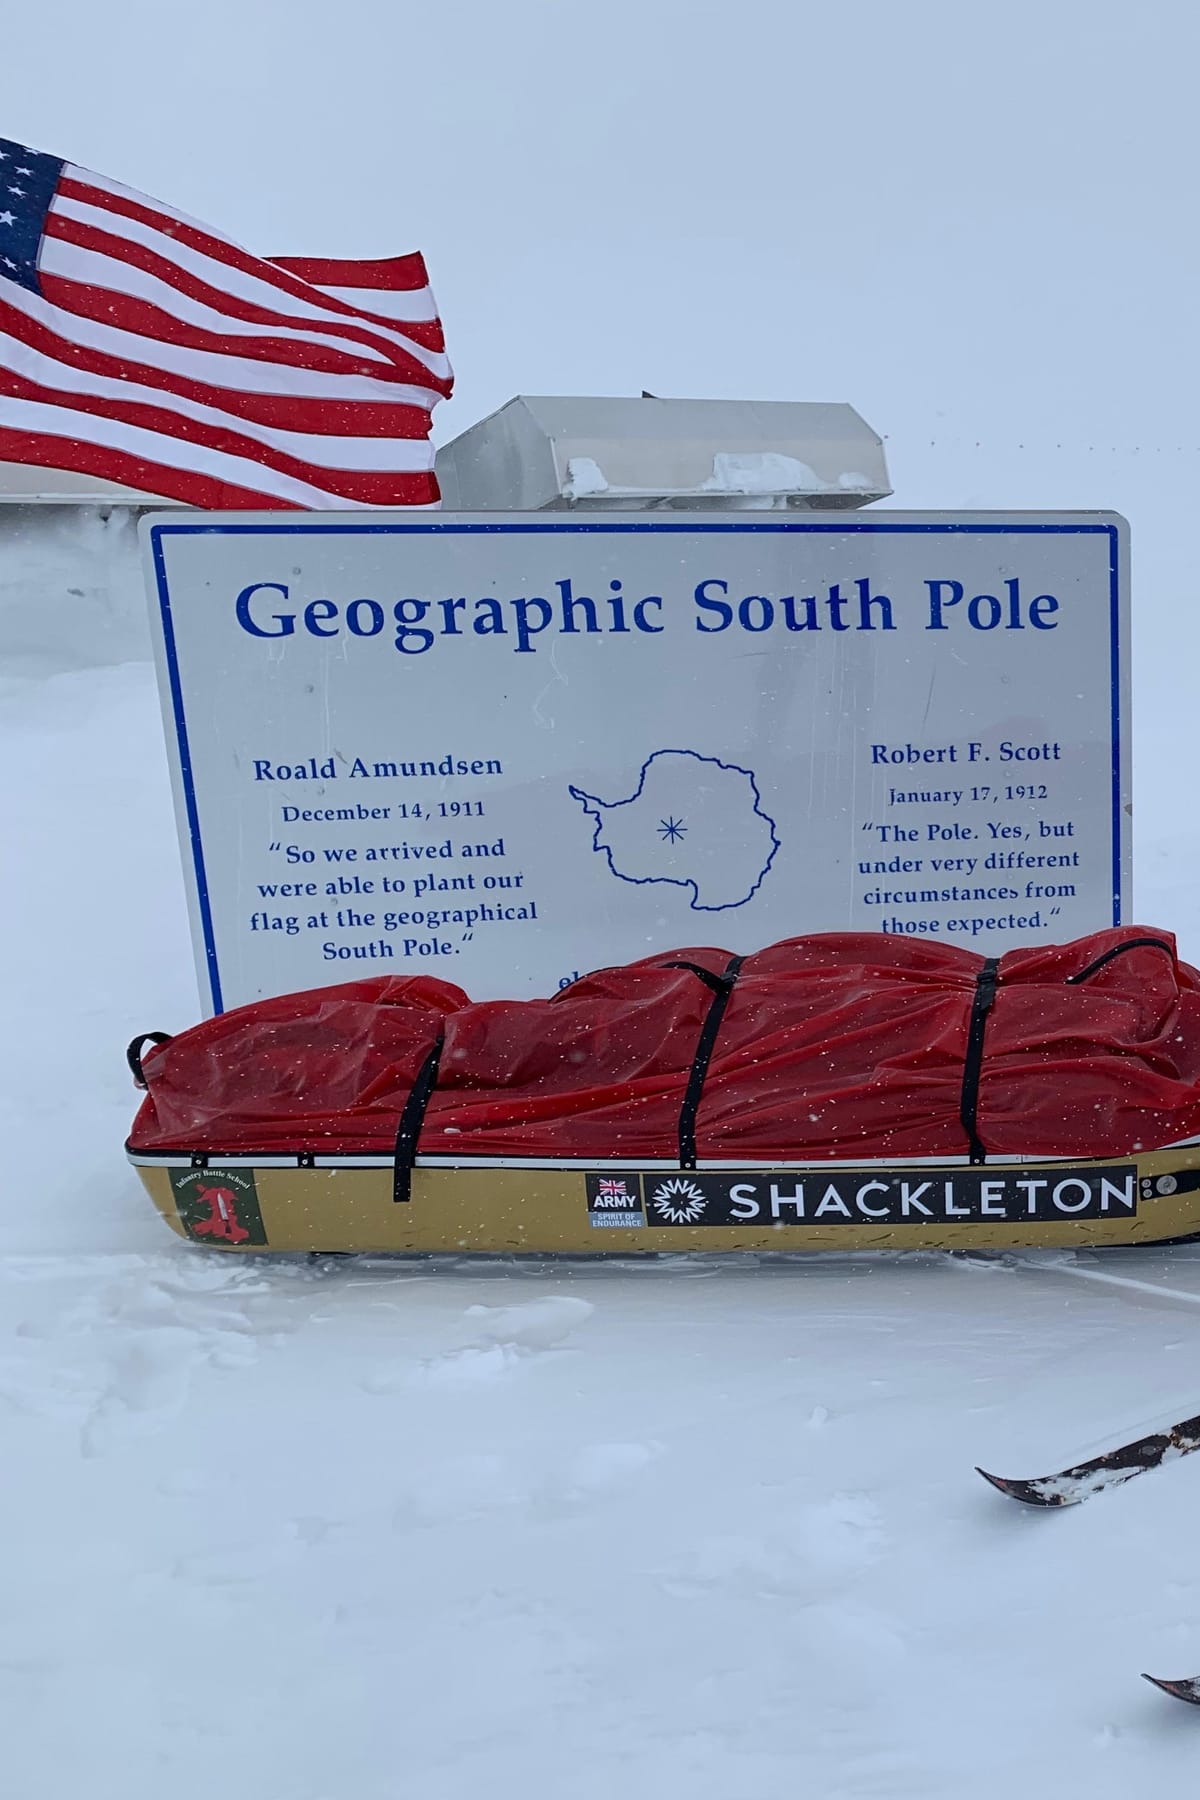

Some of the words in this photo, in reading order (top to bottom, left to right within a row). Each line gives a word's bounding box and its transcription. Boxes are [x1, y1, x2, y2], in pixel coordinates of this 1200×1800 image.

[235, 578, 665, 655] Geographic
[694, 577, 898, 633] South
[923, 577, 1059, 631] Pole
[870, 743, 958, 764] Robert
[967, 742, 990, 762] F.
[999, 741, 1061, 762] Scott
[252, 757, 337, 781] Roald
[348, 754, 504, 779] Amundsen
[889, 788, 964, 807] January
[970, 786, 998, 804] 17,
[1005, 785, 1048, 800] 1912
[281, 803, 391, 823] December
[398, 802, 431, 822] 14,
[437, 800, 485, 818] 1911
[927, 823, 979, 841] Pole.
[986, 822, 1030, 841] Yes,
[1038, 820, 1074, 838] but
[322, 848, 358, 863] we
[365, 839, 454, 861] arrived
[461, 838, 506, 858] and
[858, 855, 923, 874] under
[930, 858, 978, 876] very
[984, 851, 1080, 870] different
[256, 882, 318, 898] were
[325, 875, 375, 896] able
[382, 876, 406, 893] to
[412, 873, 476, 898] plant
[483, 875, 524, 889] our
[863, 886, 1019, 905] circumstances
[1025, 881, 1076, 898] from
[250, 911, 300, 936] flag
[306, 911, 329, 929] at
[336, 908, 376, 928] the
[383, 901, 538, 932] geographical
[882, 916, 940, 934] those
[322, 939, 394, 961] South
[175, 1172, 201, 1189] Infantry
[203, 1169, 226, 1178] Battle
[226, 1173, 251, 1190] School
[593, 1195, 637, 1208] ARMY
[729, 1175, 1134, 1219] SHACKLETON
[597, 1213, 625, 1221] SPIRIT
[626, 1213, 636, 1221] OF
